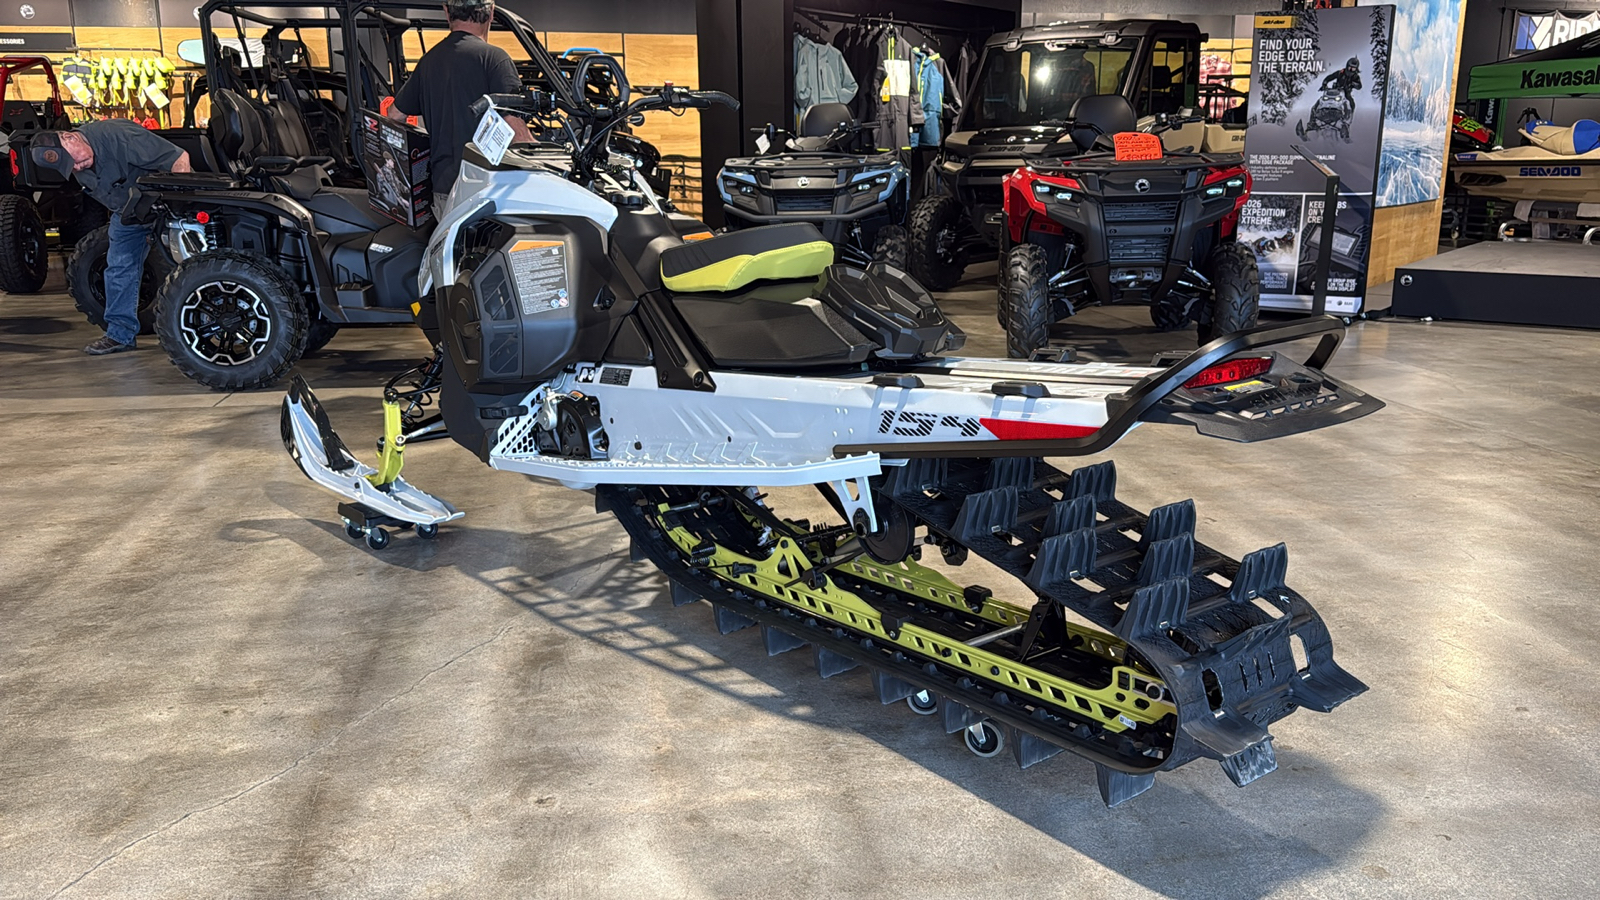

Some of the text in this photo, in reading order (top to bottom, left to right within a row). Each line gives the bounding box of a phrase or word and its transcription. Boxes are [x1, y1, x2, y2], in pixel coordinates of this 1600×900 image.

[1259, 38, 1313, 50] FIND YOUR
[1258, 50, 1315, 61] EDGE OVER
[1258, 61, 1326, 73] THE TERRAIN.
[1242, 208, 1286, 218] EXPEDITION
[1241, 216, 1272, 225] XTREME
[878, 409, 981, 437] 154
